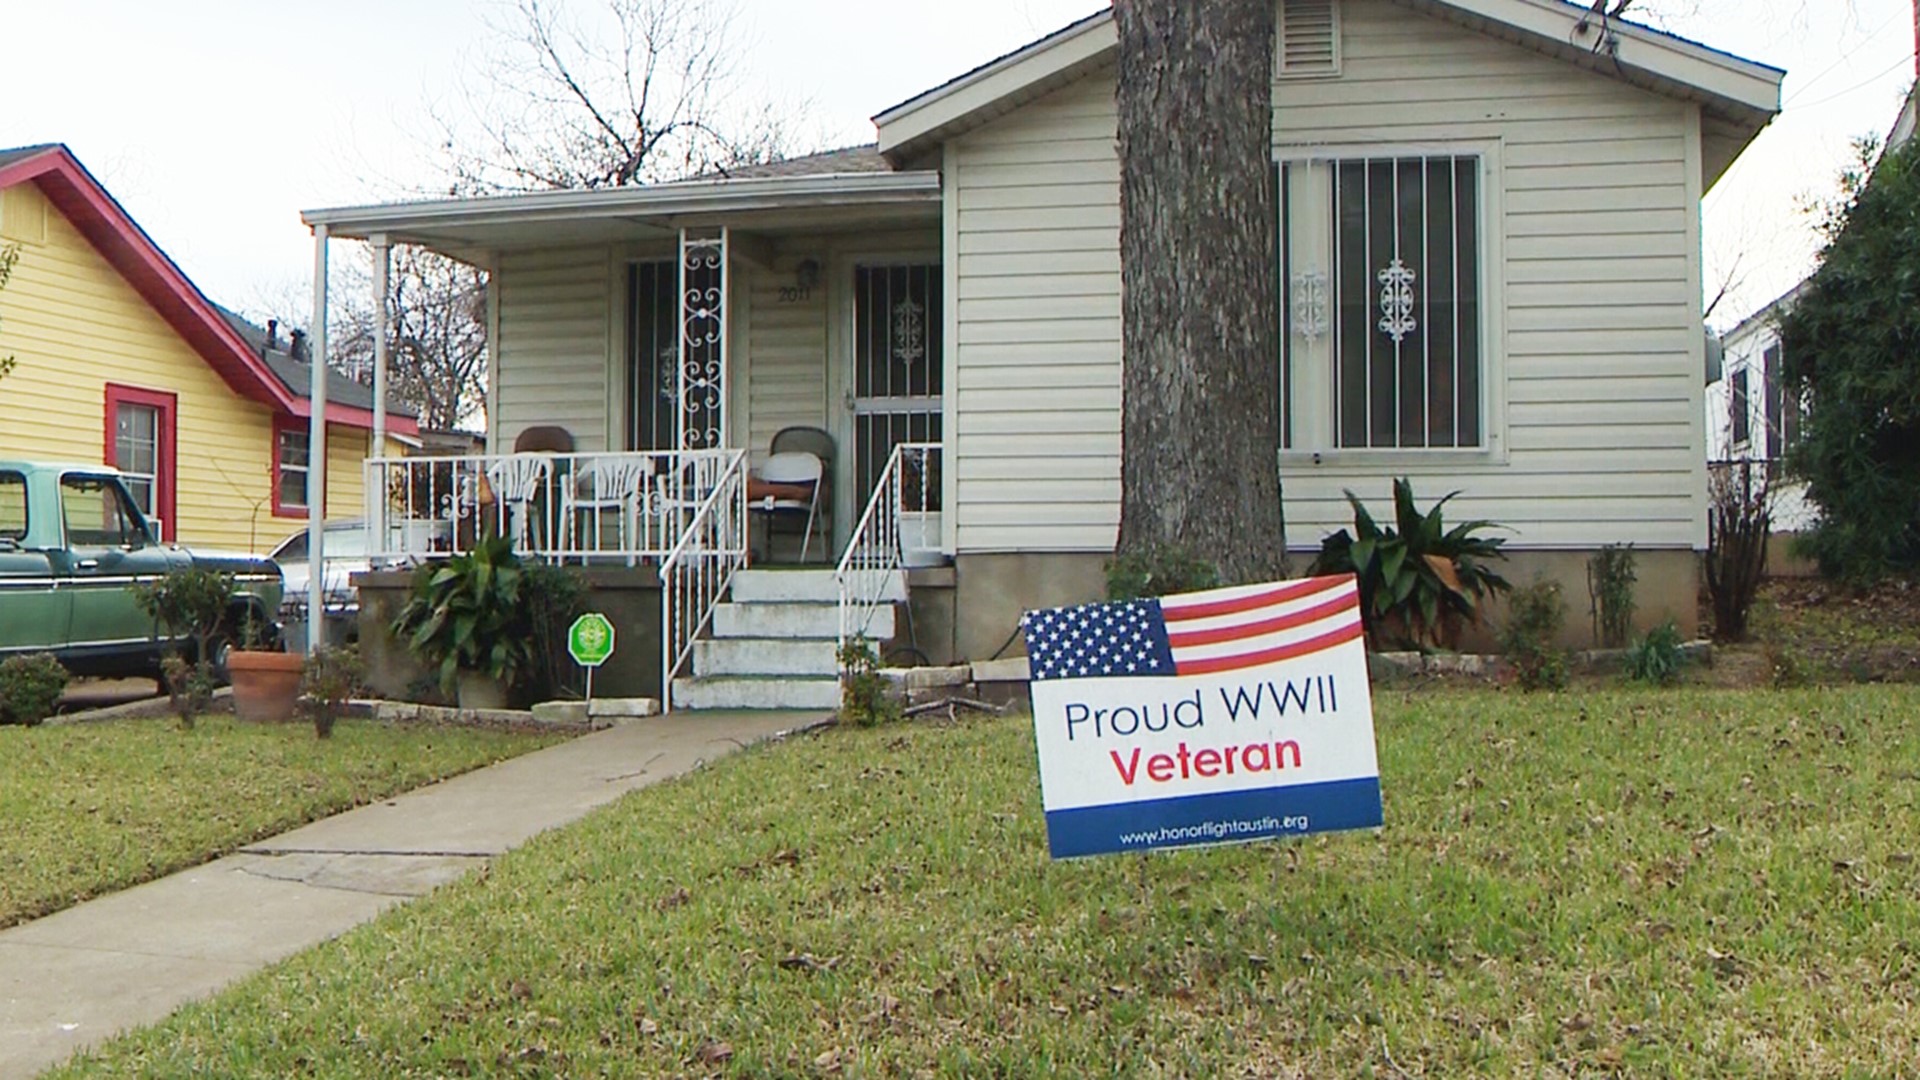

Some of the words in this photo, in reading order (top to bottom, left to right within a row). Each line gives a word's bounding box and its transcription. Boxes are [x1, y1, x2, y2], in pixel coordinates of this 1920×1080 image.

[778, 286, 811, 302] 2011
[1065, 689, 1204, 741] Proud
[1220, 675, 1338, 722] WWII
[1110, 739, 1302, 786] Veteran
[1119, 814, 1309, 846] www.honorflightaustin.org
